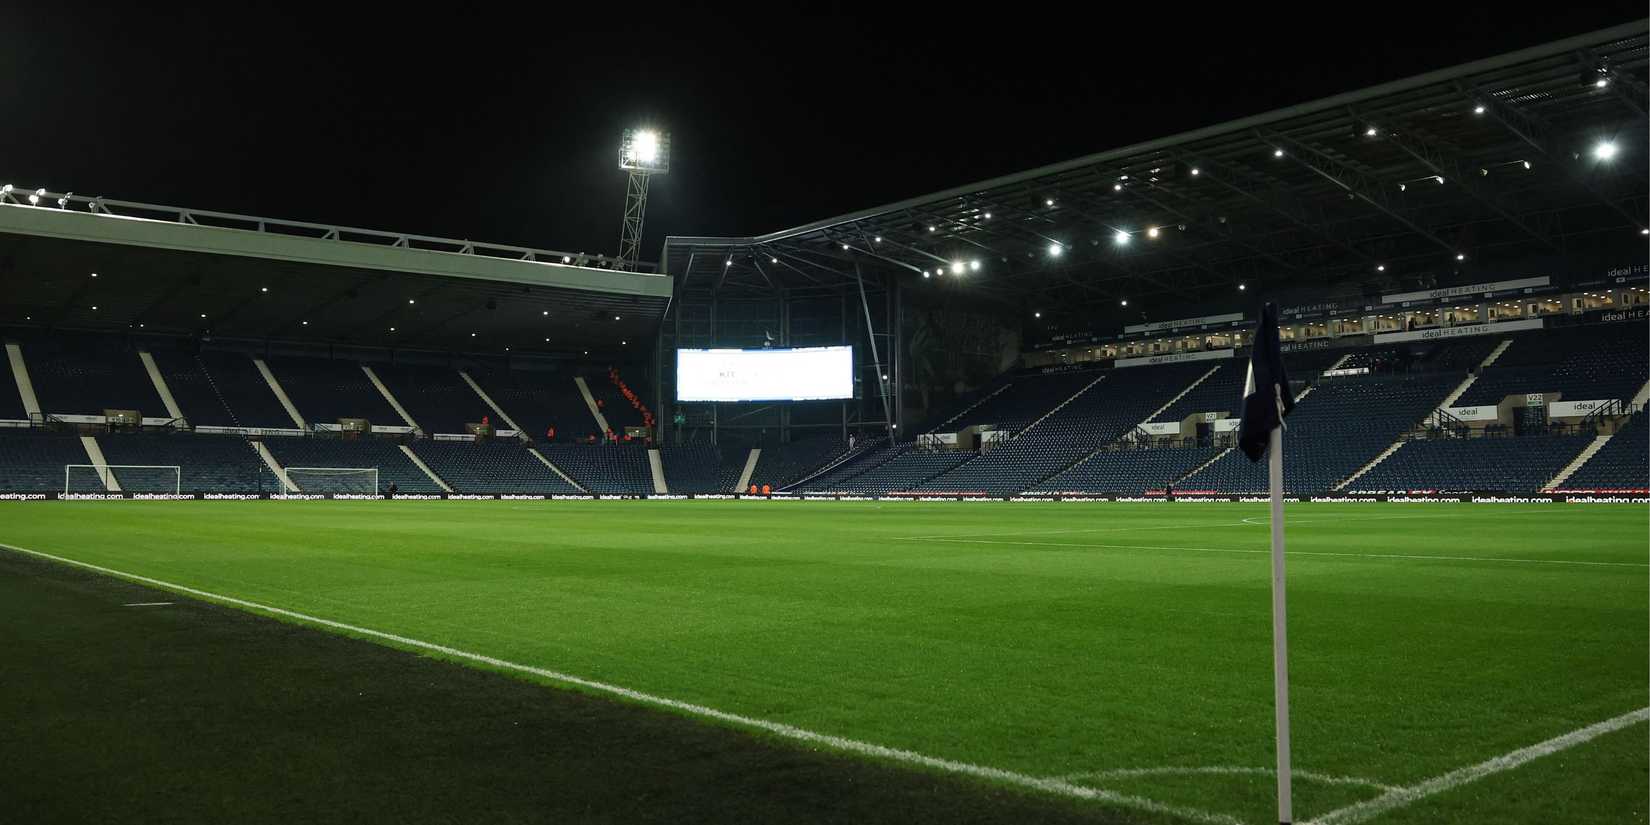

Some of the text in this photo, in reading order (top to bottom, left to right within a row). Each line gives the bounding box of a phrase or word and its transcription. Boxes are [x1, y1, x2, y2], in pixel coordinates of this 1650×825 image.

[1430, 285, 1496, 298] ideal HEATING
[1422, 326, 1488, 339] ideal HEATING
[1458, 408, 1478, 416] ideal
[1573, 402, 1596, 411] ideal
